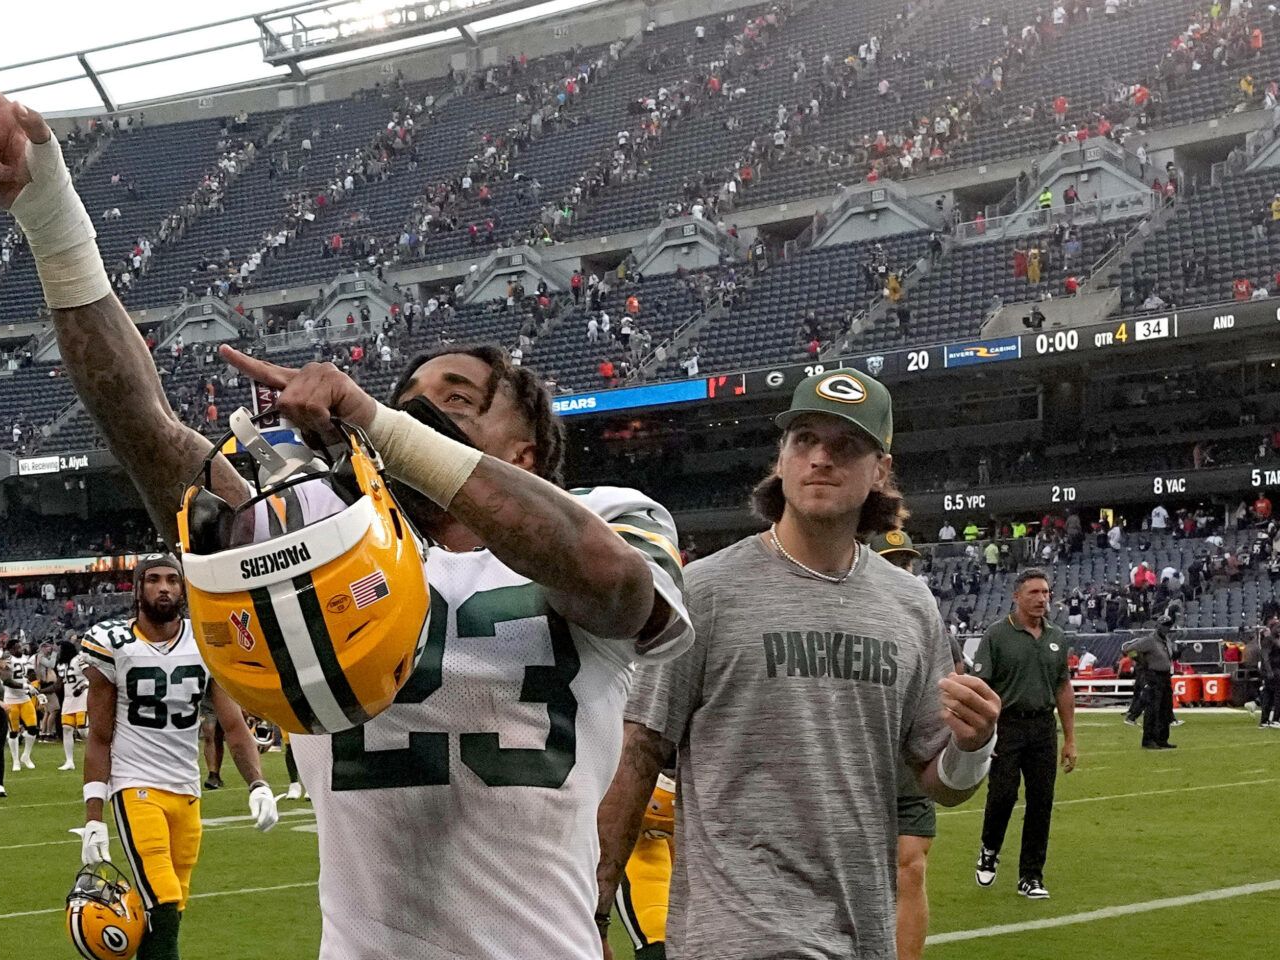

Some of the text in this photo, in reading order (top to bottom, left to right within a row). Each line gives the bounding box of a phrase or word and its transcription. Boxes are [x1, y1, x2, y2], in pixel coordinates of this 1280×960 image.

[1213, 315, 1235, 330] AND
[1035, 321, 1162, 354] 0:00 QTR 4 34
[949, 344, 1017, 359] RIVERS CASINO
[907, 351, 929, 371] 20
[552, 397, 597, 411] BEARS
[20, 454, 89, 473] NFL Receiving 3. Aiyuk
[1153, 477, 1186, 495] 8 YAC
[1252, 469, 1261, 486] 5
[944, 494, 985, 511] 6.5 YPC
[1052, 486, 1076, 502] 2 TD
[241, 541, 312, 580] PACKERS
[762, 630, 899, 687] PACKERS
[331, 580, 582, 791] 23
[1173, 680, 1218, 696] G G
[126, 664, 210, 730] 83
